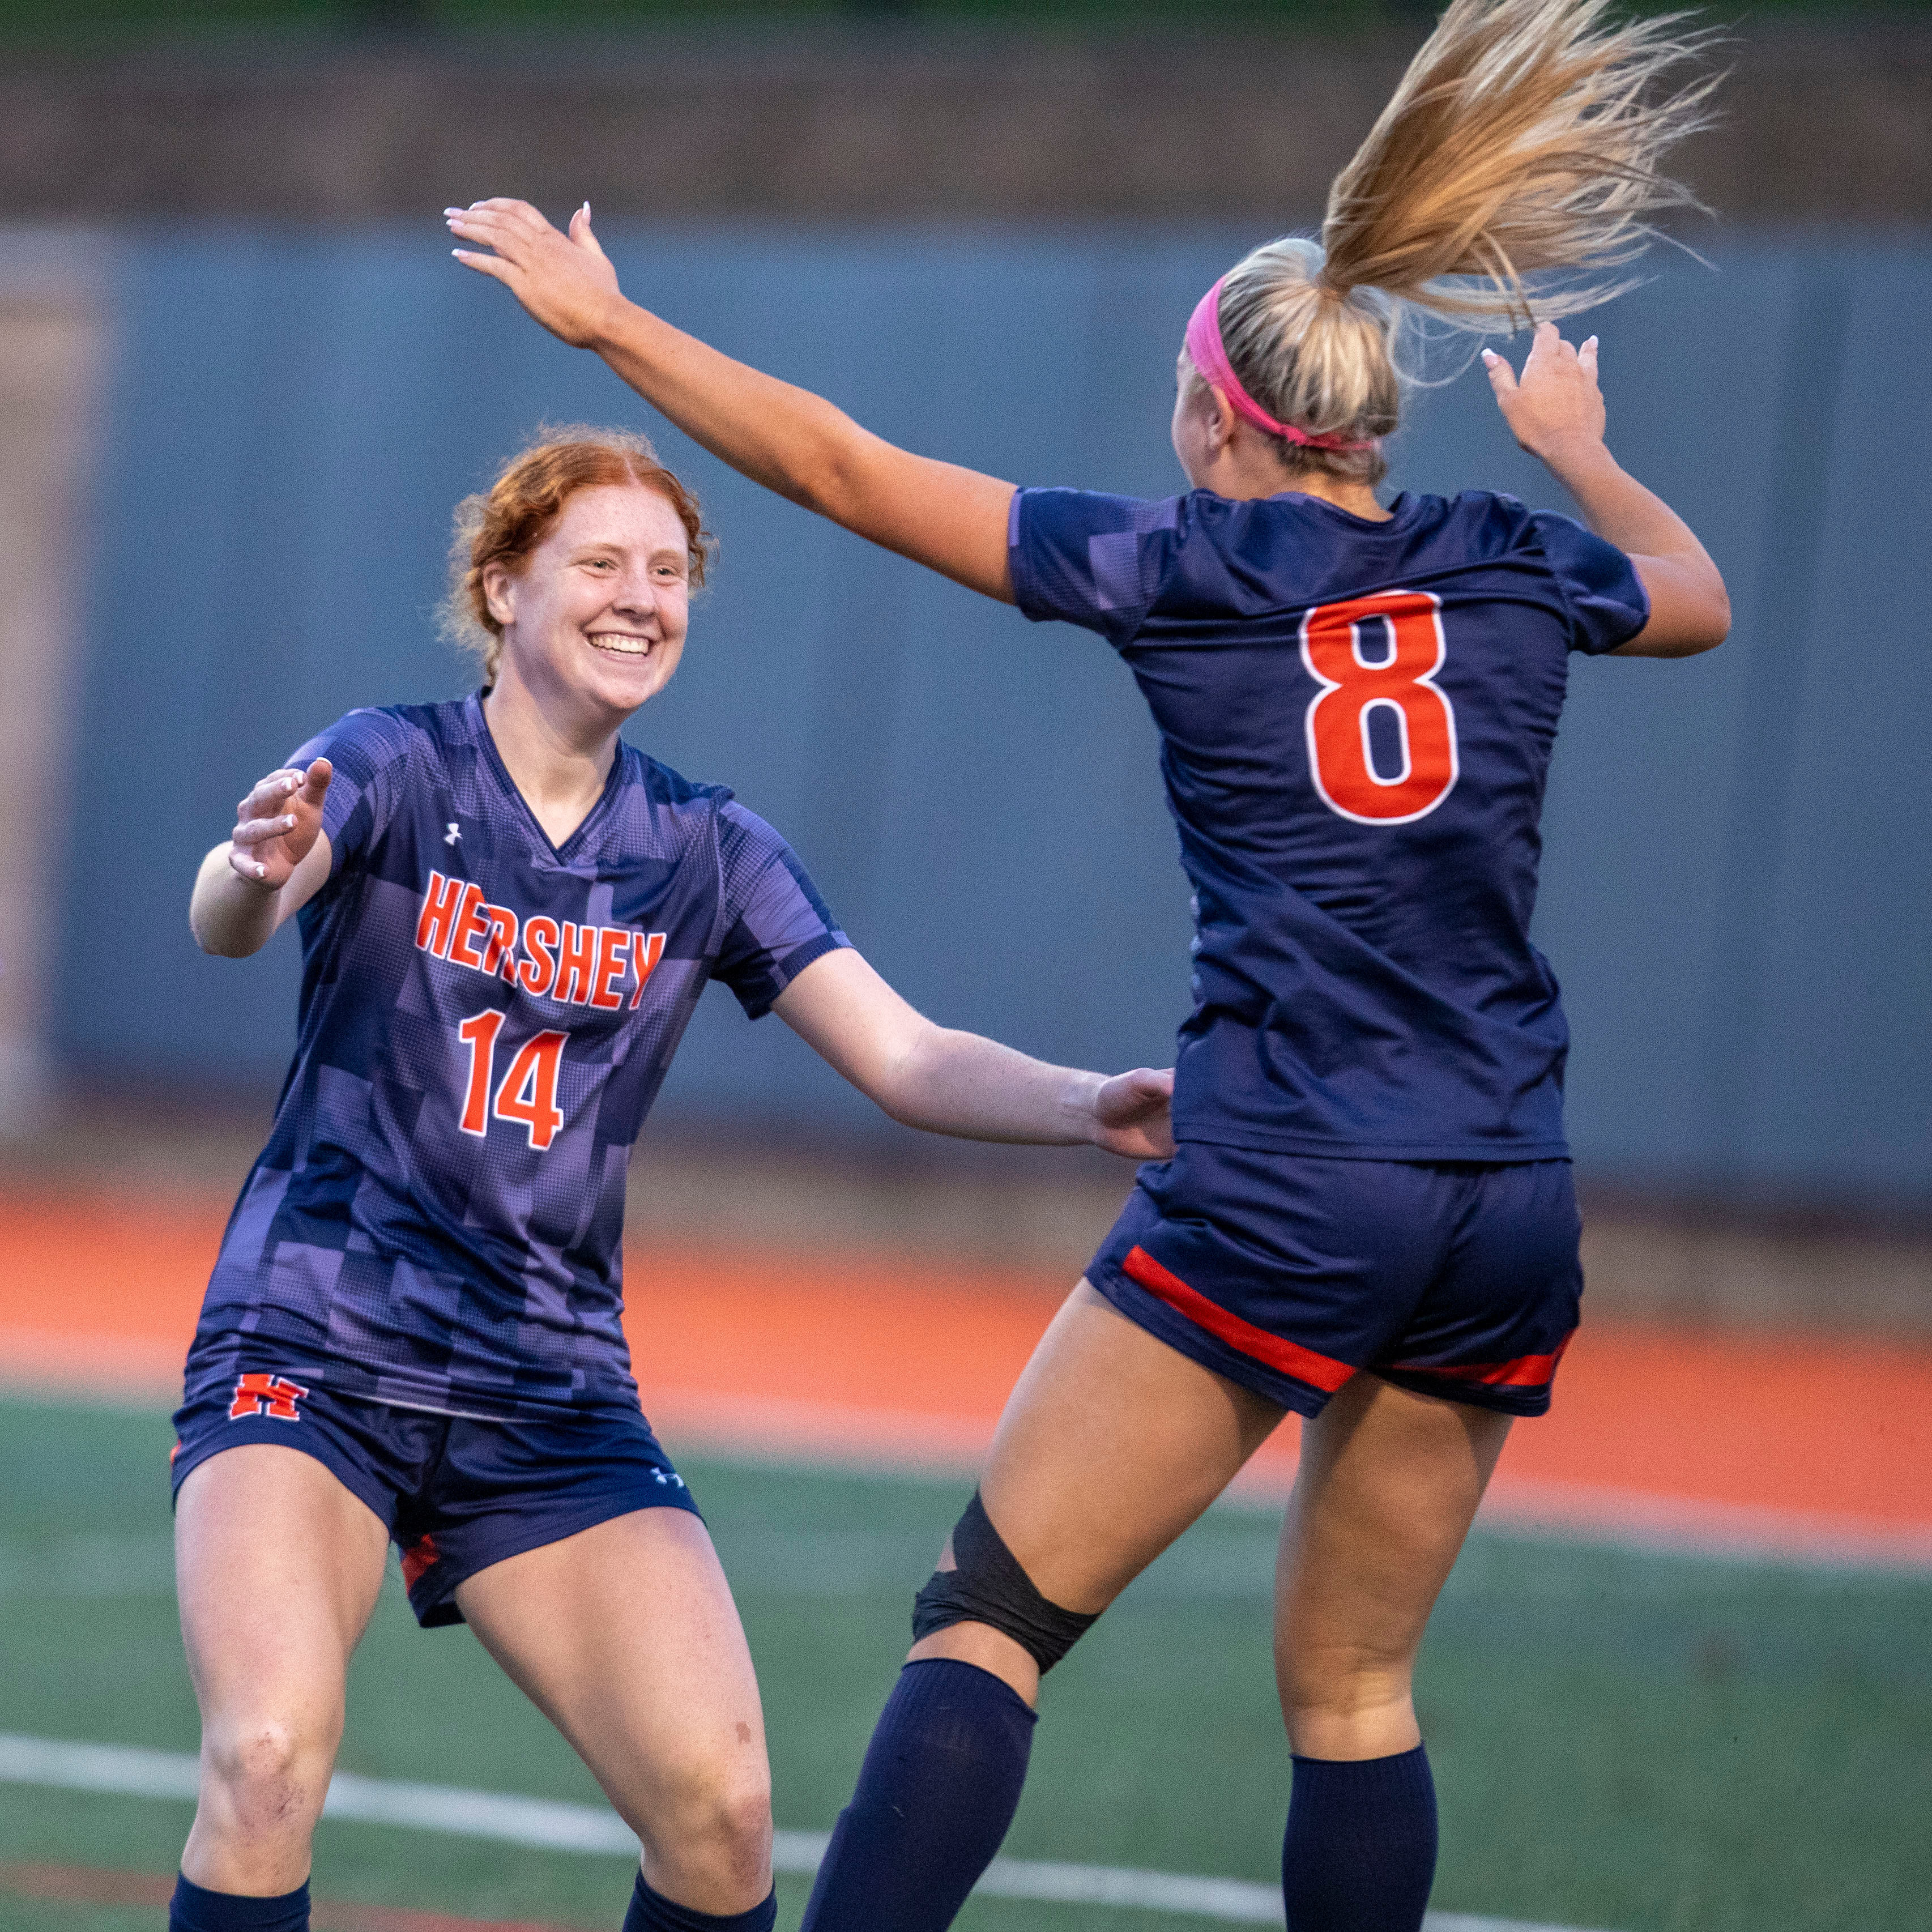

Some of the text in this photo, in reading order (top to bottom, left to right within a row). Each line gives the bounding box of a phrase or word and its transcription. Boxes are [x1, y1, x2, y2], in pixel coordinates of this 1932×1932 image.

[1298, 589, 1460, 825] 8
[415, 870, 666, 1010] HERSHEY
[458, 1008, 570, 1151] 14
[229, 1374, 309, 1422] H
